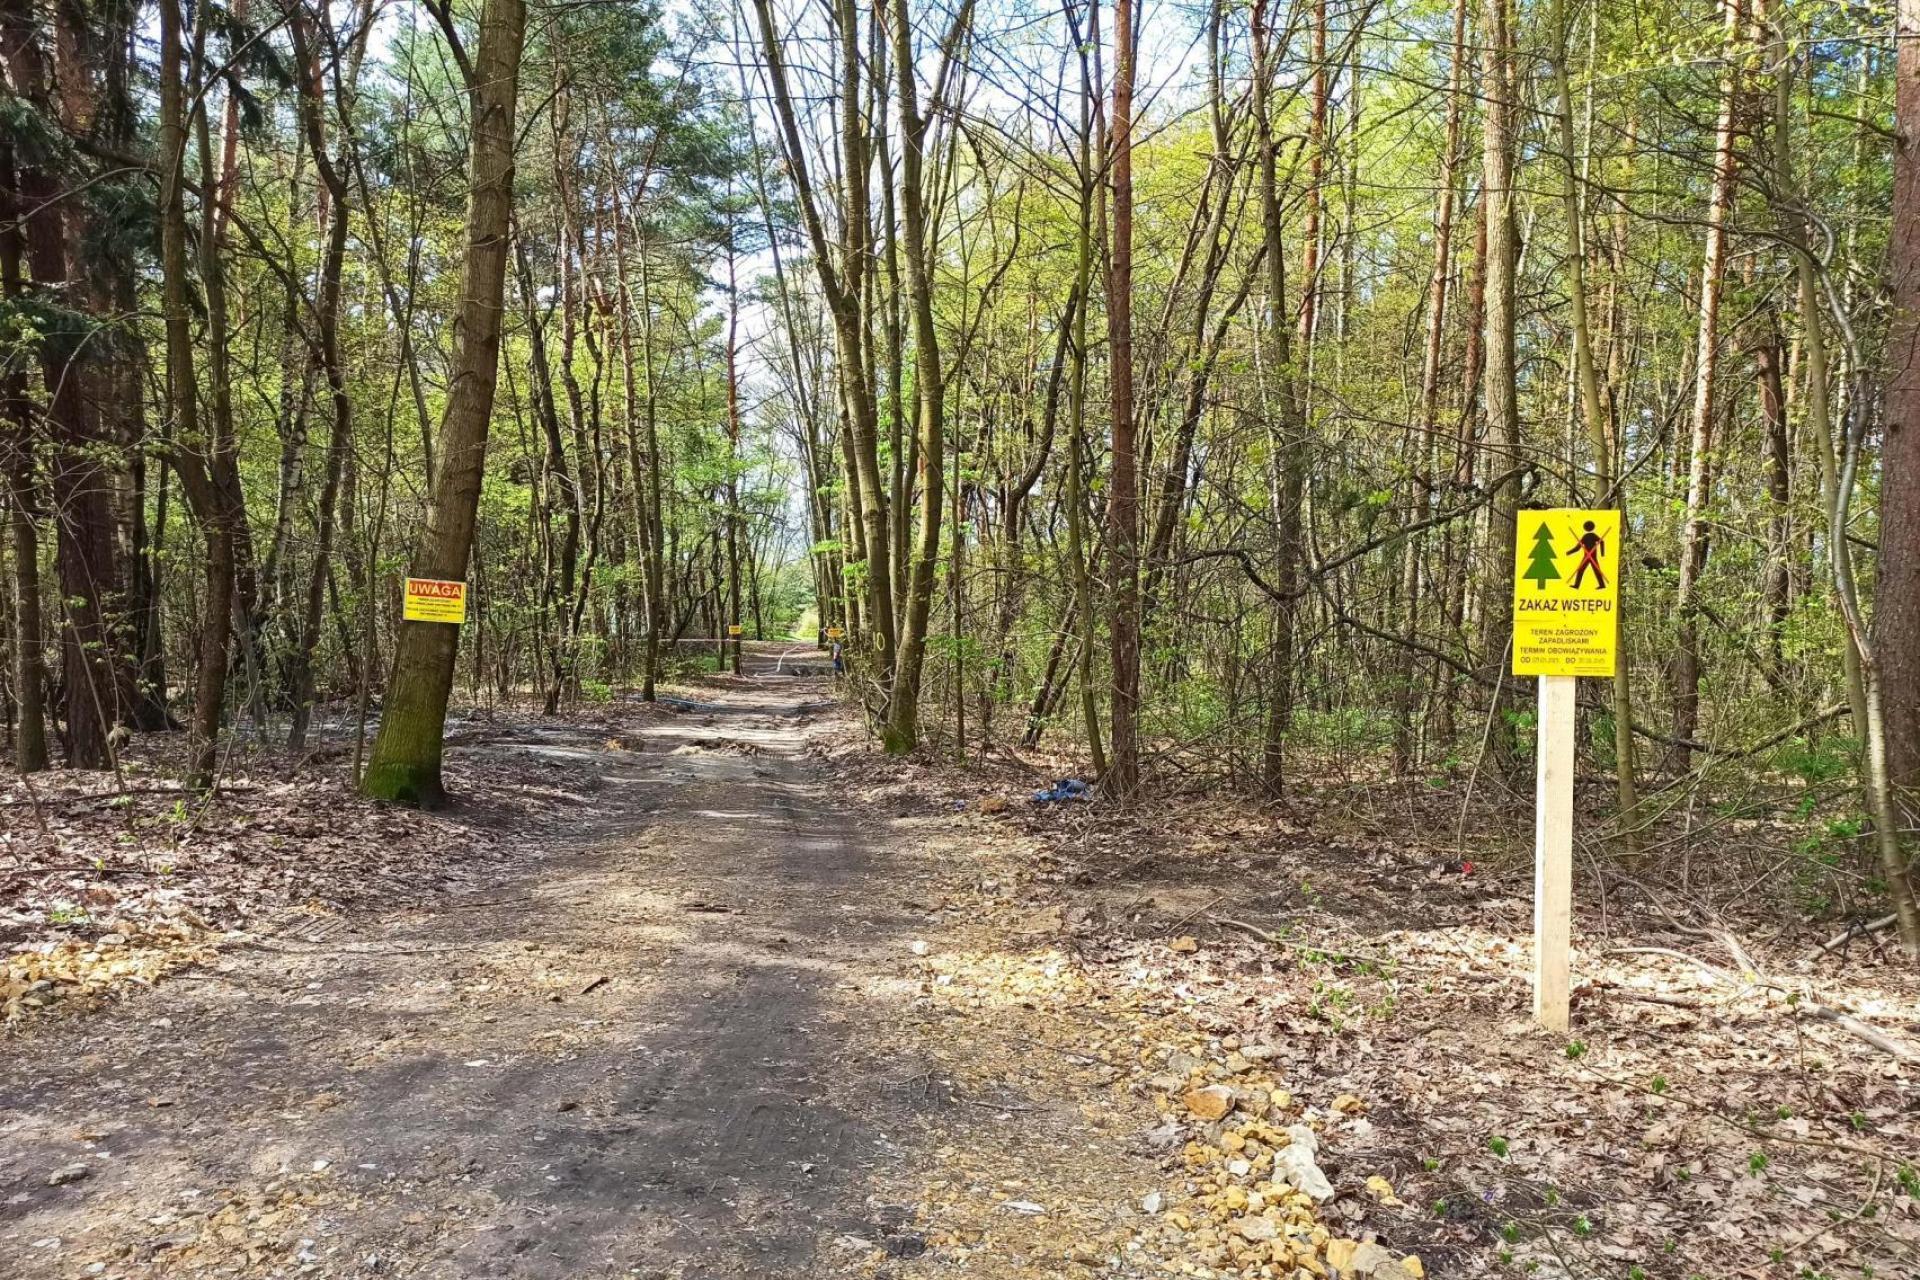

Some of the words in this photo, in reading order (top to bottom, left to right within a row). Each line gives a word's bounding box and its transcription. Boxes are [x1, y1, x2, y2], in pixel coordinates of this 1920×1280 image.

[409, 583, 461, 597] UWAGA
[1519, 599, 1558, 611] ZAKAZ
[1561, 599, 1611, 614] WSTĘPU
